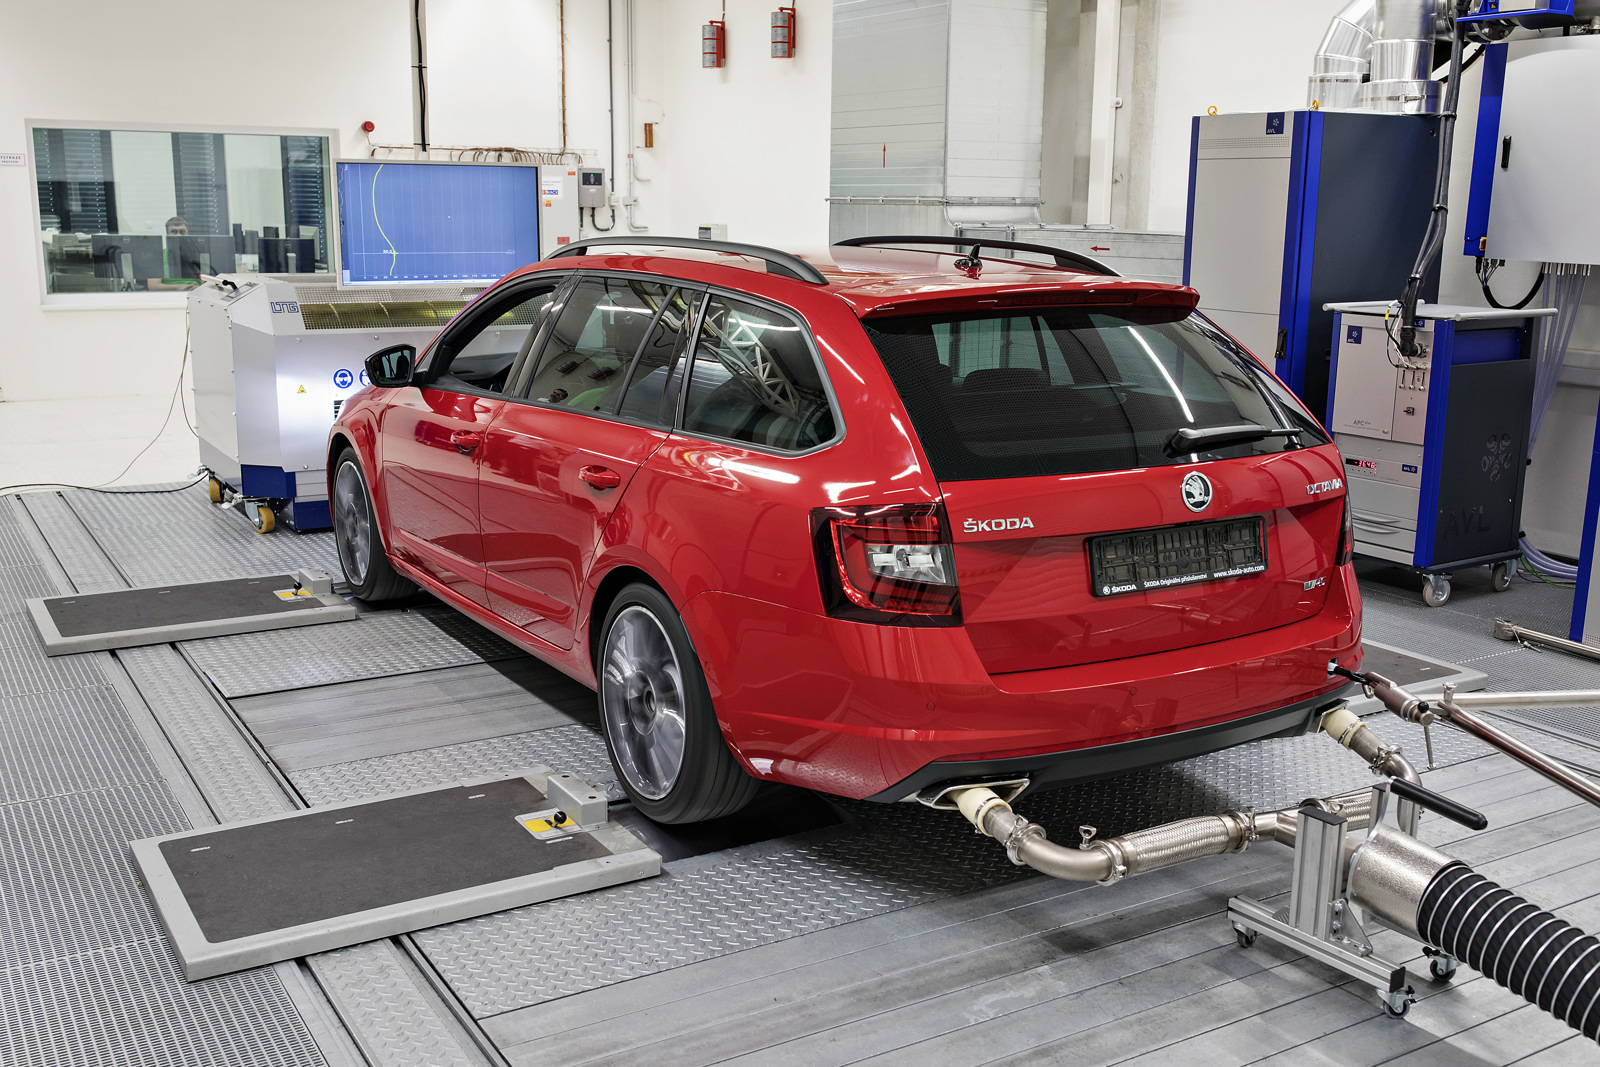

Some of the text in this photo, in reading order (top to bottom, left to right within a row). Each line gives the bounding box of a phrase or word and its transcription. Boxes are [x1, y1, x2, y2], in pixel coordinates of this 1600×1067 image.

[270, 301, 300, 314] LTG
[1306, 478, 1344, 496] OCTAVIA
[963, 516, 1035, 533] ŠKODA
[1111, 584, 1138, 594] ŠKODA
[1144, 580, 1160, 588] ŠKODA
[1213, 565, 1265, 578] www.skoda-auto.com
